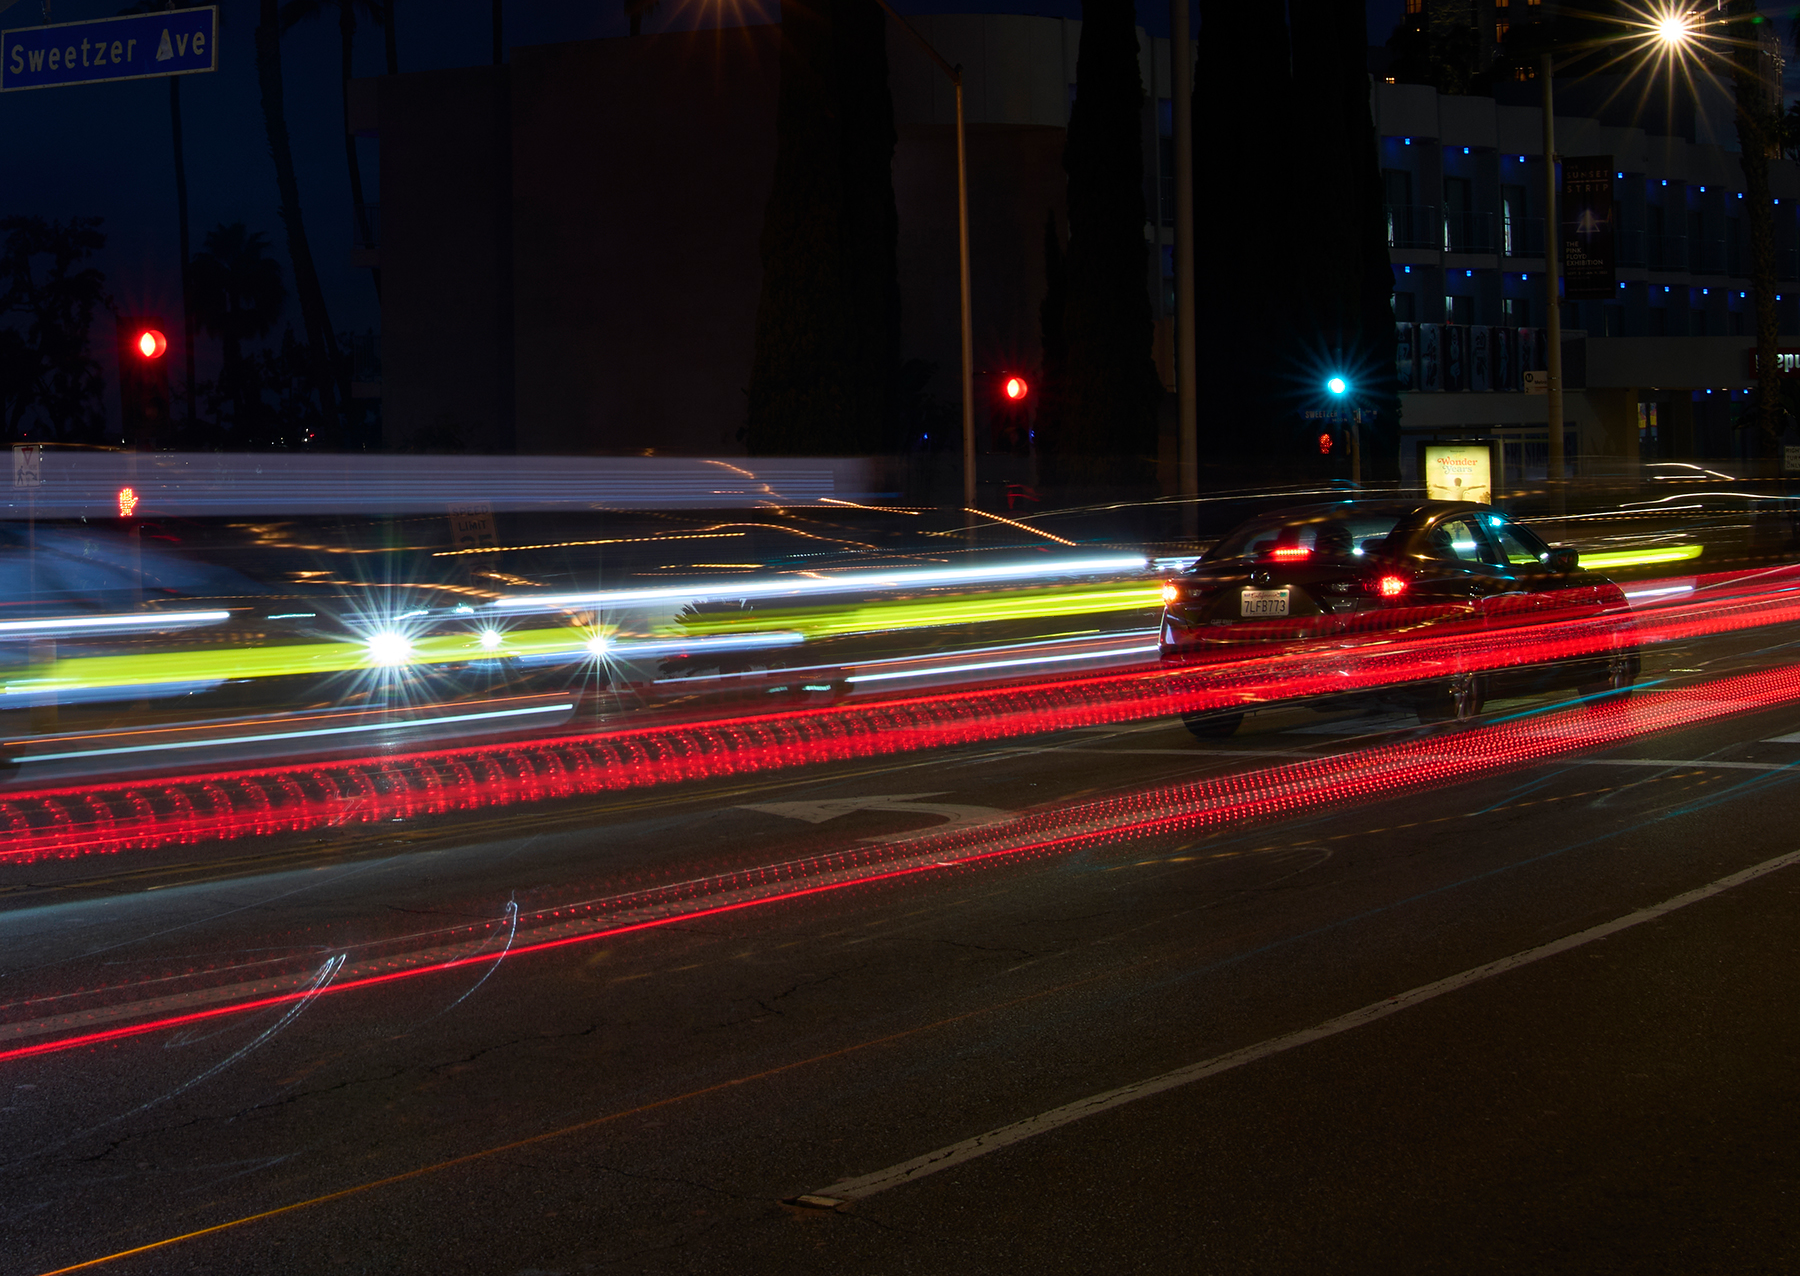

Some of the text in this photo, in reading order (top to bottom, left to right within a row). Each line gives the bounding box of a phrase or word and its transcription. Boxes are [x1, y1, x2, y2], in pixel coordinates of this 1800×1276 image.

[9, 28, 206, 75] Sweetzer Ave
[1566, 170, 1609, 179] SUNSET
[1566, 184, 1609, 193] STRIP
[1437, 456, 1478, 466] Wonder
[1442, 465, 1473, 474] Years
[452, 505, 488, 516] SPEED
[458, 520, 486, 531] LIMIT
[1244, 600, 1286, 612] 7LFB773
